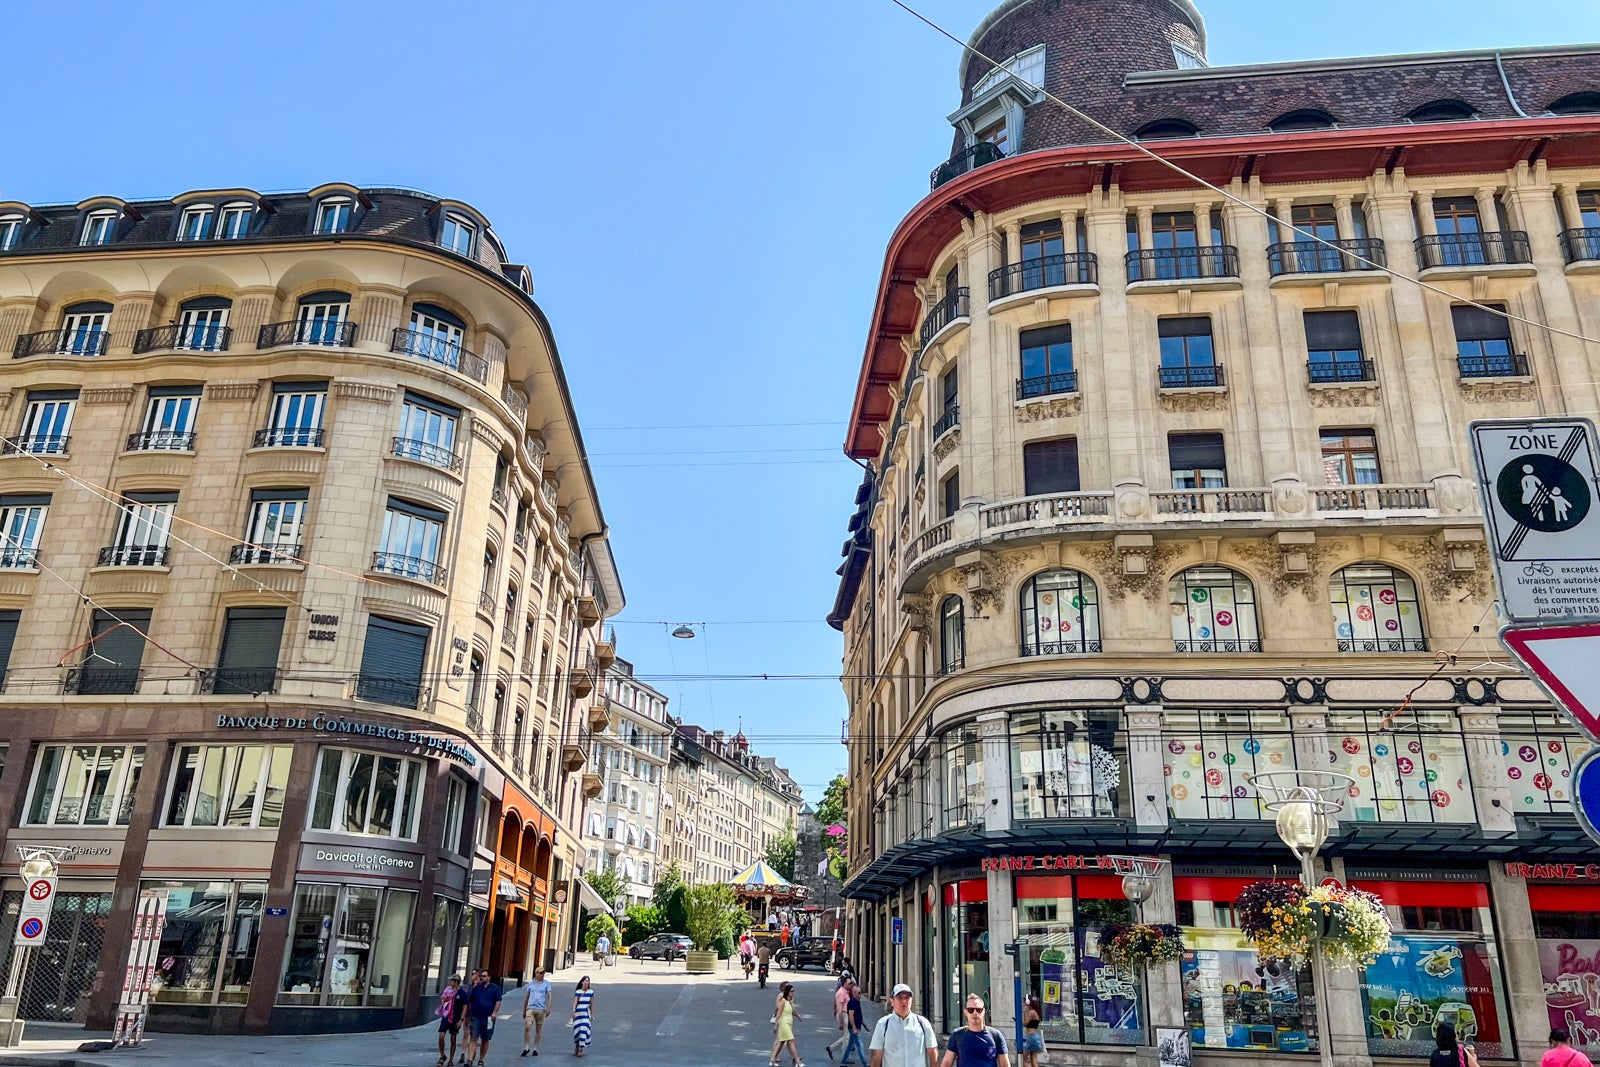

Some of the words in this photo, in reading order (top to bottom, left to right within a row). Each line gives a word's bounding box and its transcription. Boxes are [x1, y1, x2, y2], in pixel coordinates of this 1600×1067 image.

[1507, 434, 1559, 450] ZONE
[1561, 565, 1599, 575] exceptés
[1517, 576, 1561, 585] Livraisons
[1532, 586, 1547, 594] dès
[1549, 586, 1598, 594] l'ouverture
[1534, 596, 1549, 604] des
[1572, 605, 1599, 614] 11h30
[311, 614, 339, 626] UNION
[308, 629, 337, 642] SUISSE
[216, 714, 280, 730] BANQUE
[285, 717, 307, 729] DE
[312, 716, 405, 740] COMMERCE
[409, 731, 425, 745] ET
[428, 736, 443, 749] DE
[71, 845, 111, 855] Geneva
[316, 850, 364, 862] Davidoff
[365, 854, 377, 864] of
[378, 855, 414, 869] Geneva
[981, 855, 1036, 872] FRANZ
[1041, 855, 1089, 870] CARL
[1505, 862, 1578, 879] FRANZ
